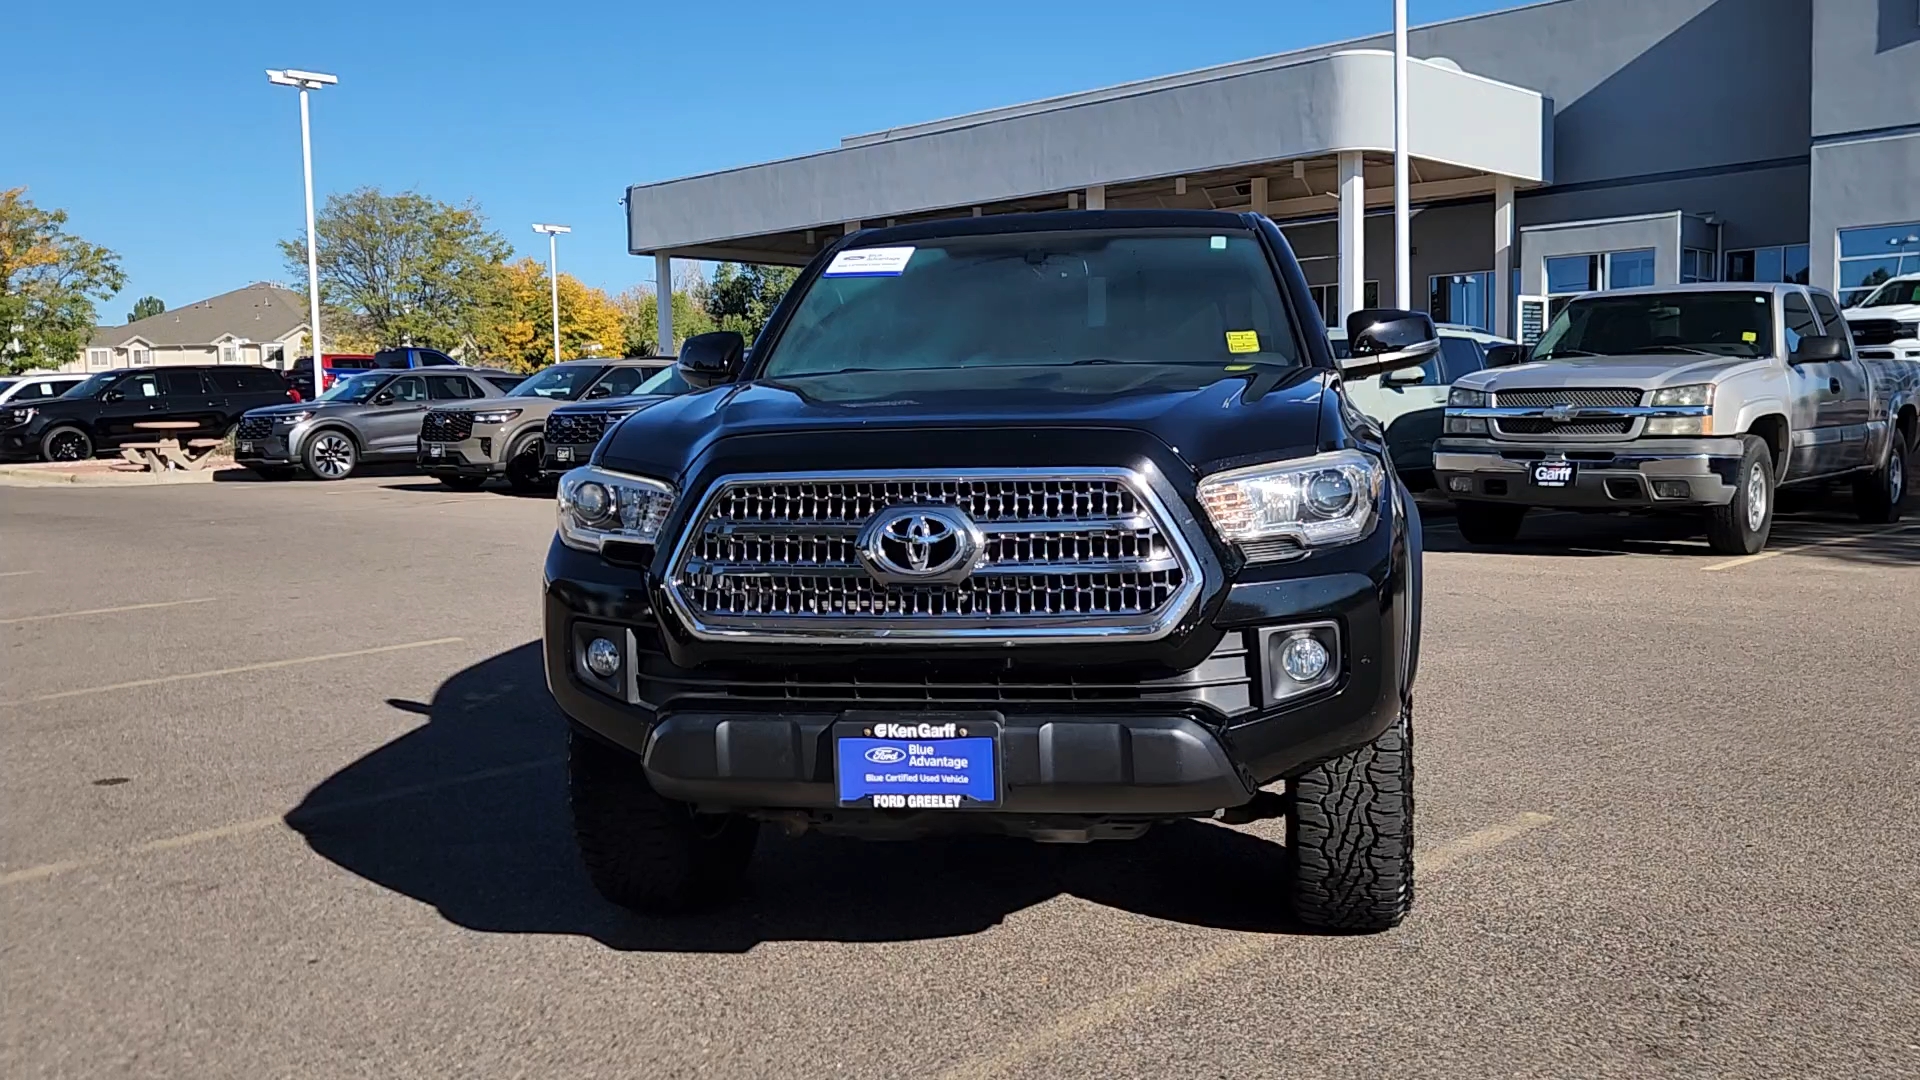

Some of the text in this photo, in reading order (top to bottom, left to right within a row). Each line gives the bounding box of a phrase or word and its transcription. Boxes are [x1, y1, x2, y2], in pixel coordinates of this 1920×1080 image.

[1535, 466, 1572, 481] Garff
[887, 723, 956, 738] Ken Garff
[873, 749, 899, 761] Ford
[908, 744, 934, 755] Blue
[909, 756, 968, 769] Advantage
[865, 773, 969, 784] Blue Certified Used Vehicle
[873, 795, 961, 808] FORD GREELEY
